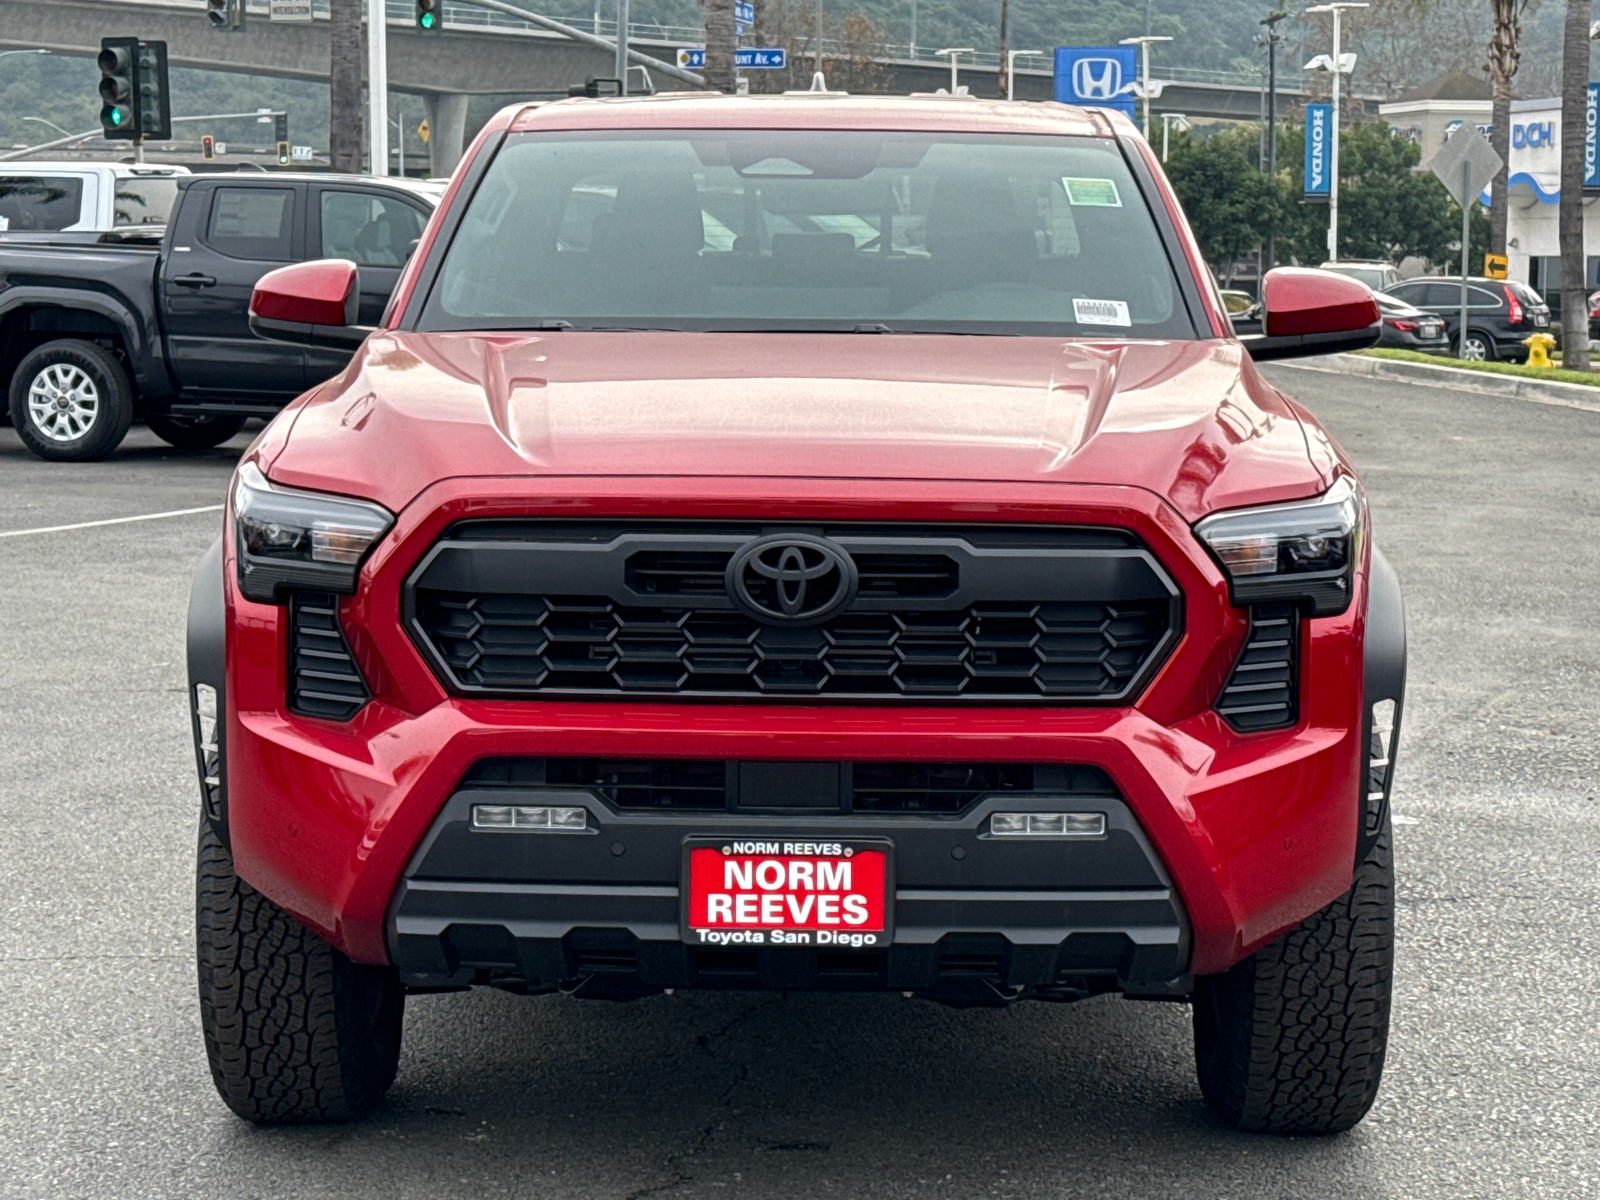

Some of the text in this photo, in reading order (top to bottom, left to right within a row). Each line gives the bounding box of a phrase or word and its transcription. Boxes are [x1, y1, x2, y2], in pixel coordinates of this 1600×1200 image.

[1312, 109, 1324, 190] HONDA
[1512, 121, 1553, 149] DCH
[1585, 88, 1598, 182] HONDA
[733, 842, 842, 856] NORM REEVES
[724, 860, 852, 891] NORM
[707, 893, 869, 925] REEVES
[696, 929, 877, 948] Toyota San Diego
